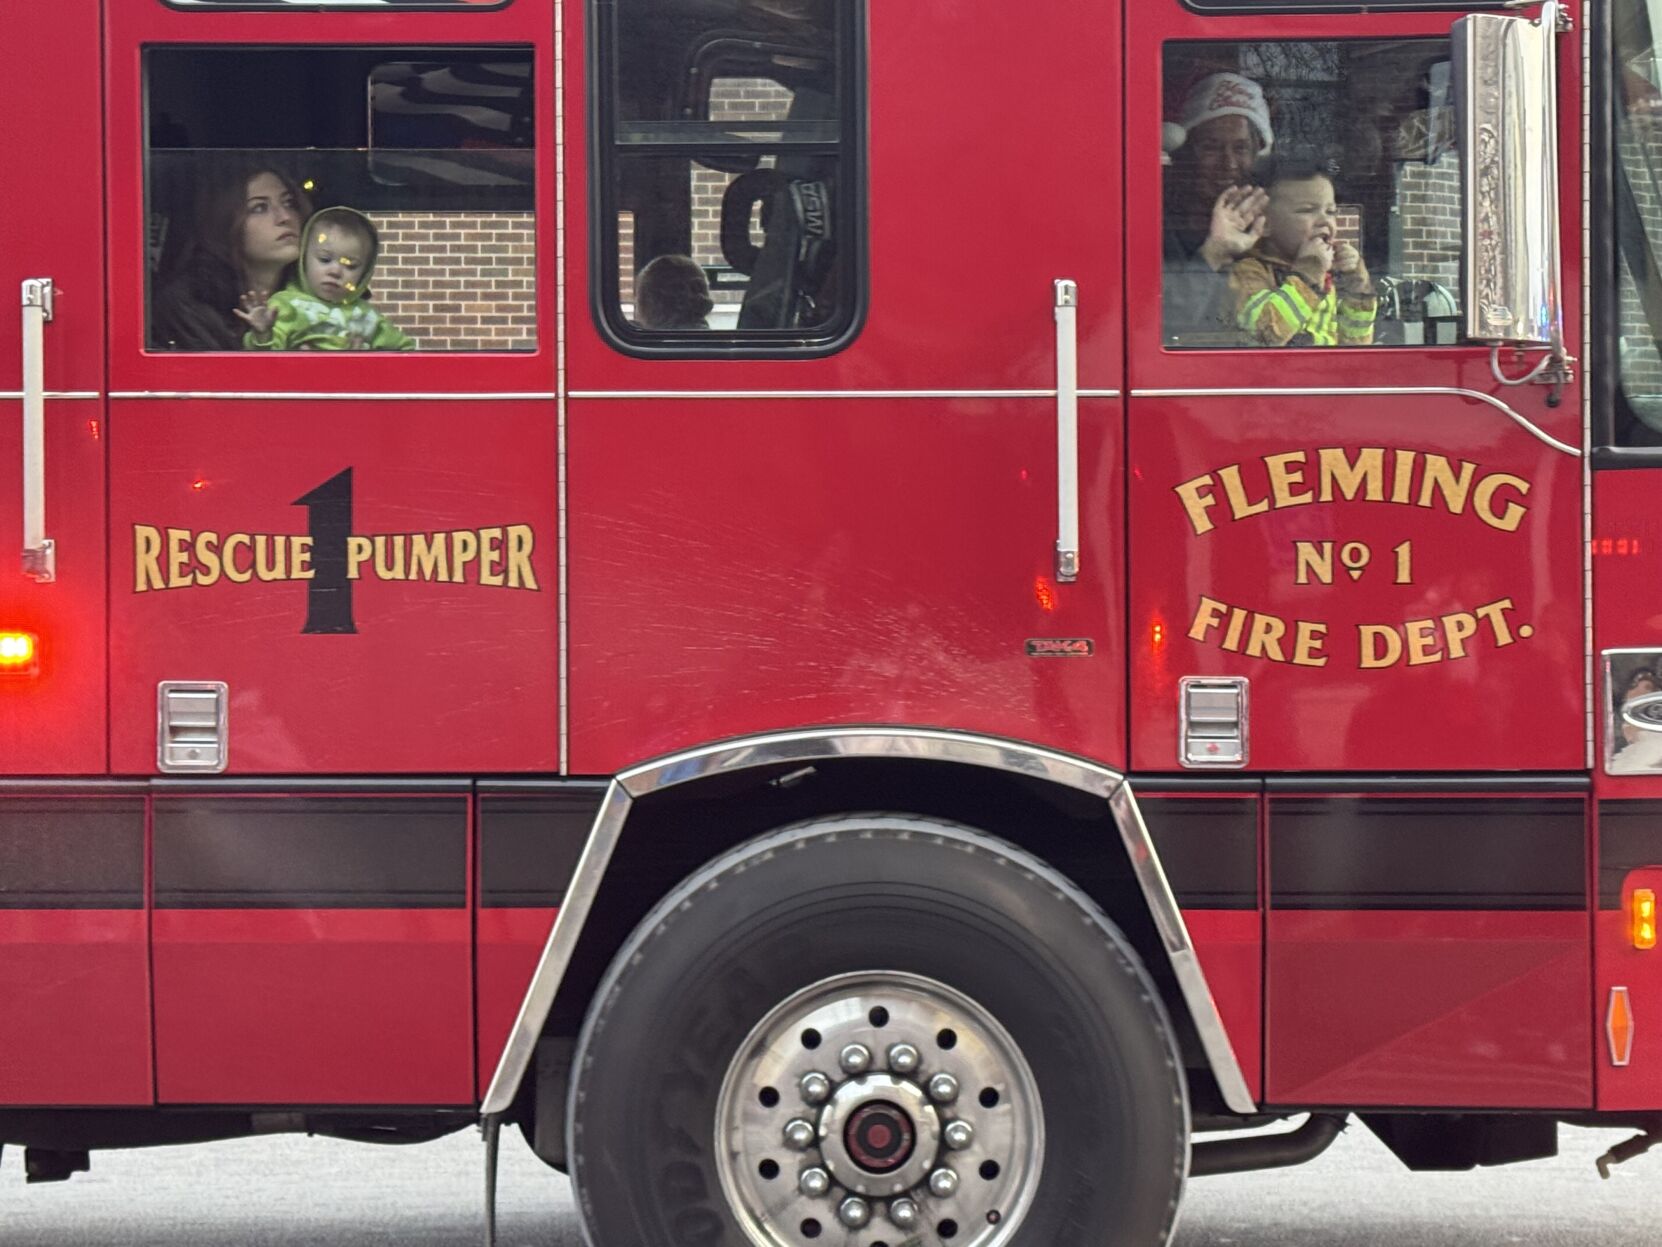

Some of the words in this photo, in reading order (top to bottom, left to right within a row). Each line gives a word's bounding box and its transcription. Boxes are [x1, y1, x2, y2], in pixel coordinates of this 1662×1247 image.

[1173, 447, 1532, 536] FLEMING
[133, 522, 316, 593] RESCUE
[345, 523, 541, 592] PUMPER
[290, 466, 359, 635] 1
[1391, 539, 1413, 585] 1
[1187, 595, 1330, 668] FIRE
[1357, 597, 1535, 669] DEPT.
